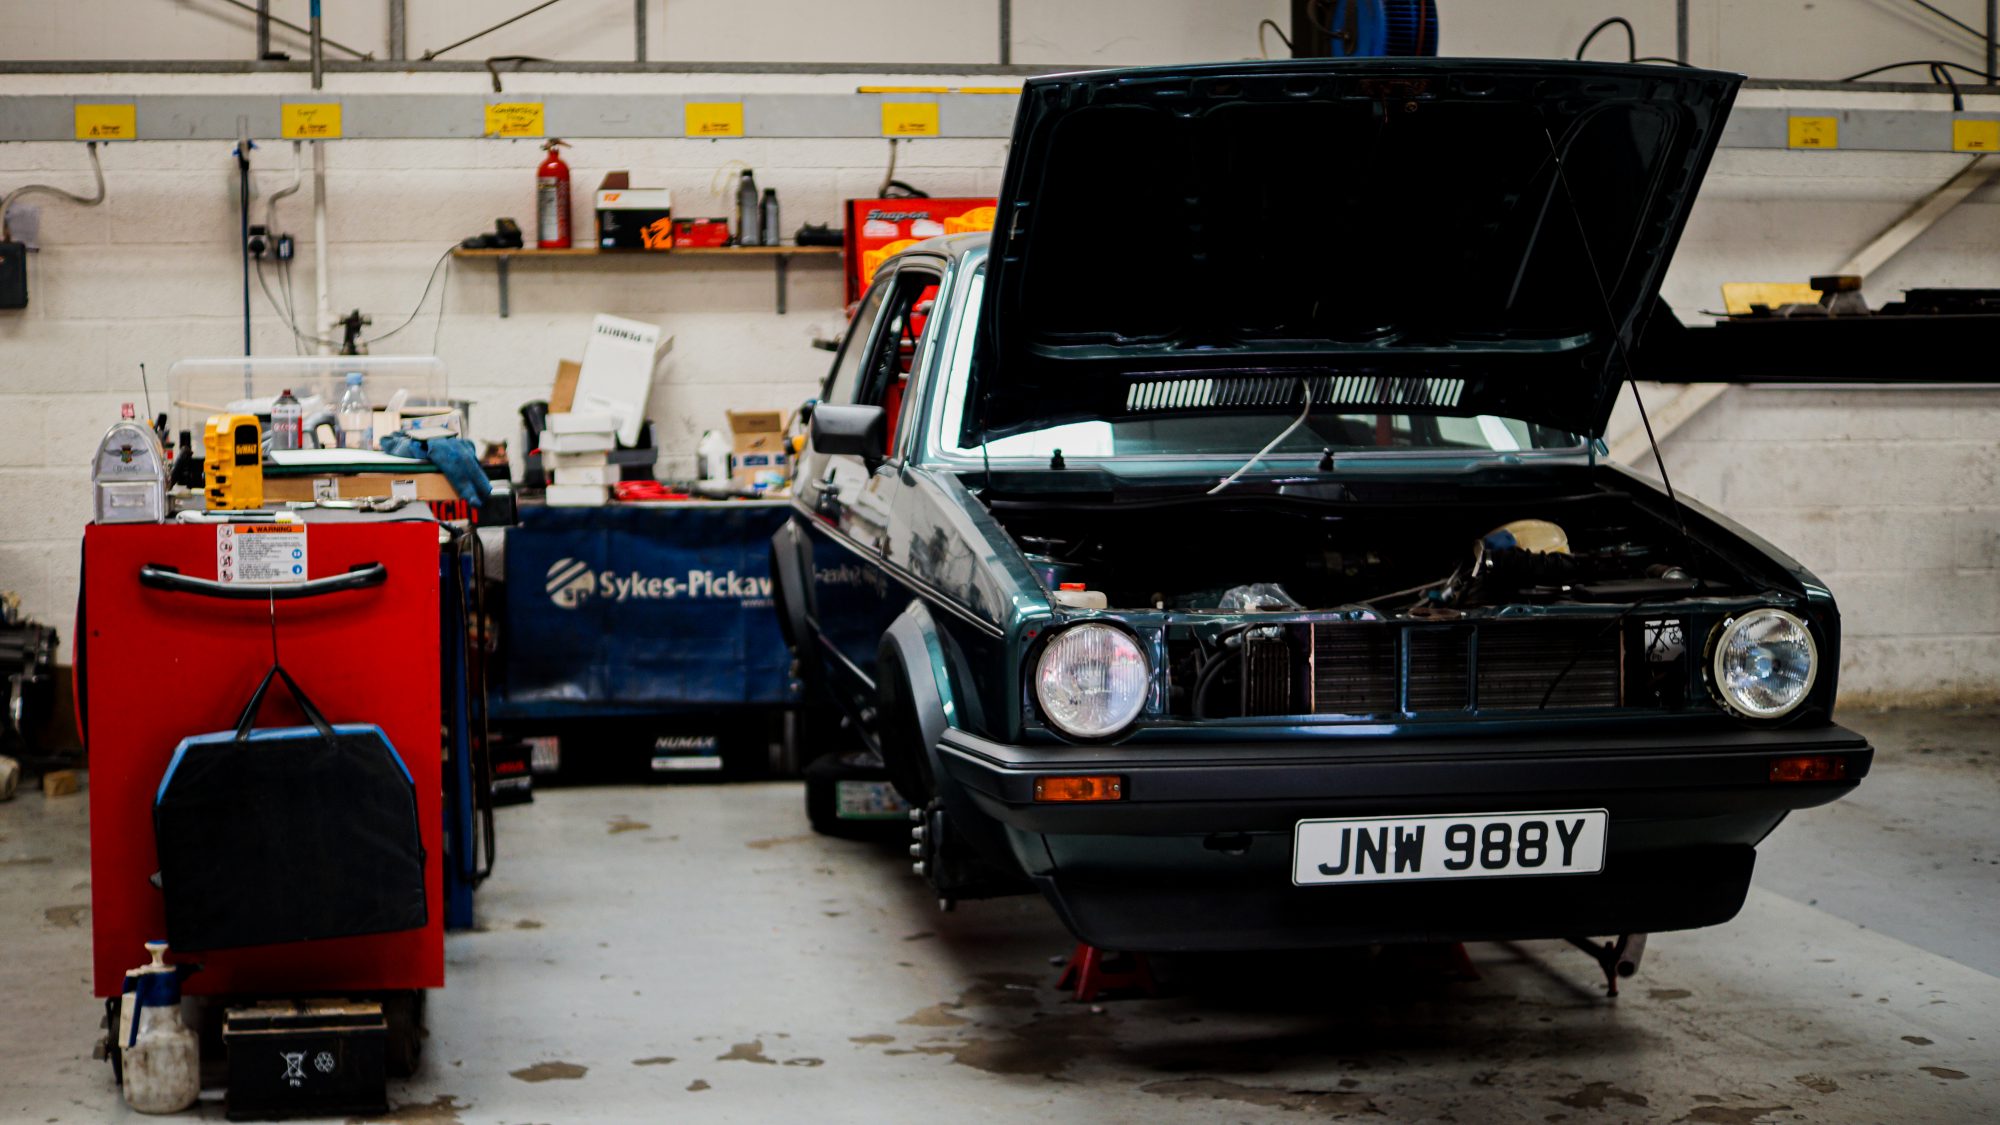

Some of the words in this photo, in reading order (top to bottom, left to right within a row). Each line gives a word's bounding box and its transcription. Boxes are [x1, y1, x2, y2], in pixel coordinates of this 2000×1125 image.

[866, 208, 930, 222] Snap-on
[256, 525, 293, 533] WARNING
[655, 736, 715, 748] NUMAX
[1318, 825, 1426, 875] JNW
[1443, 818, 1586, 871] 988Y
